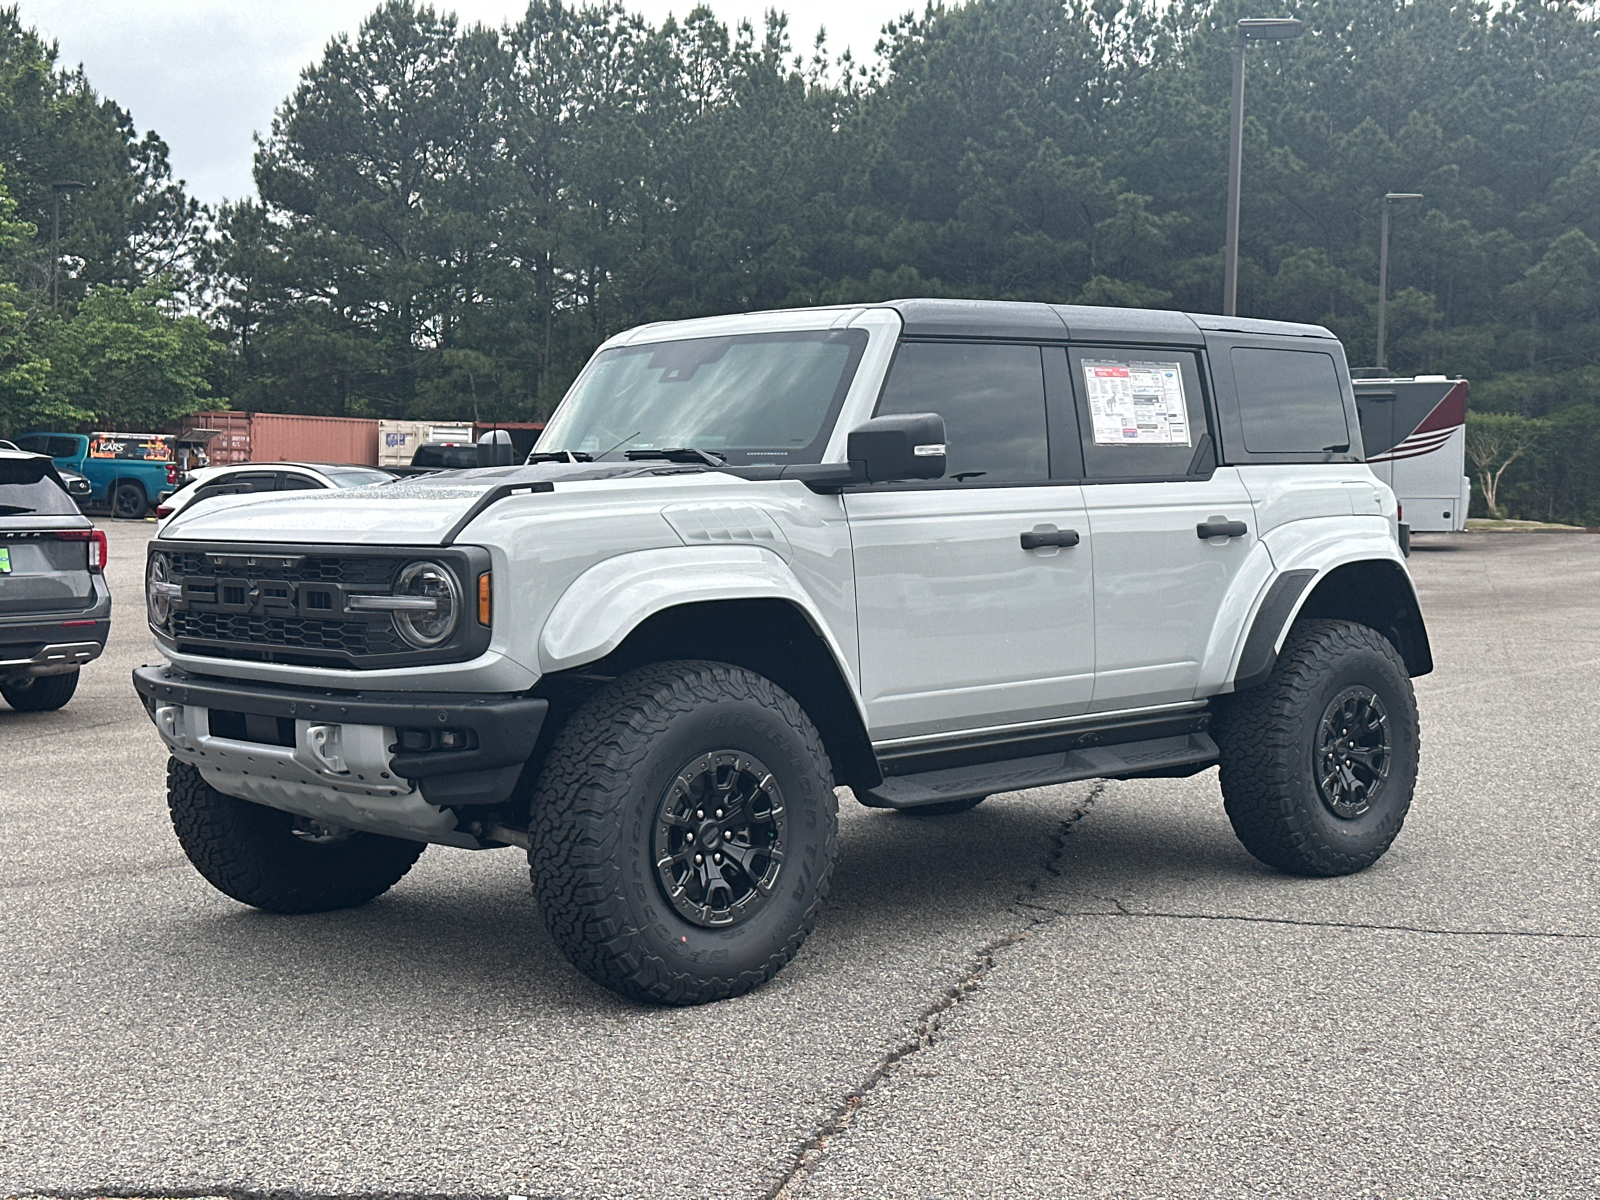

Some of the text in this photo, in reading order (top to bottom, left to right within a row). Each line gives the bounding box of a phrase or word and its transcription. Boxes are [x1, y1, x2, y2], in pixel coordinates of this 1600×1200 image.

[100, 442, 127, 452] KARS
[180, 575, 345, 619] FORD
[791, 844, 818, 901] T/A
